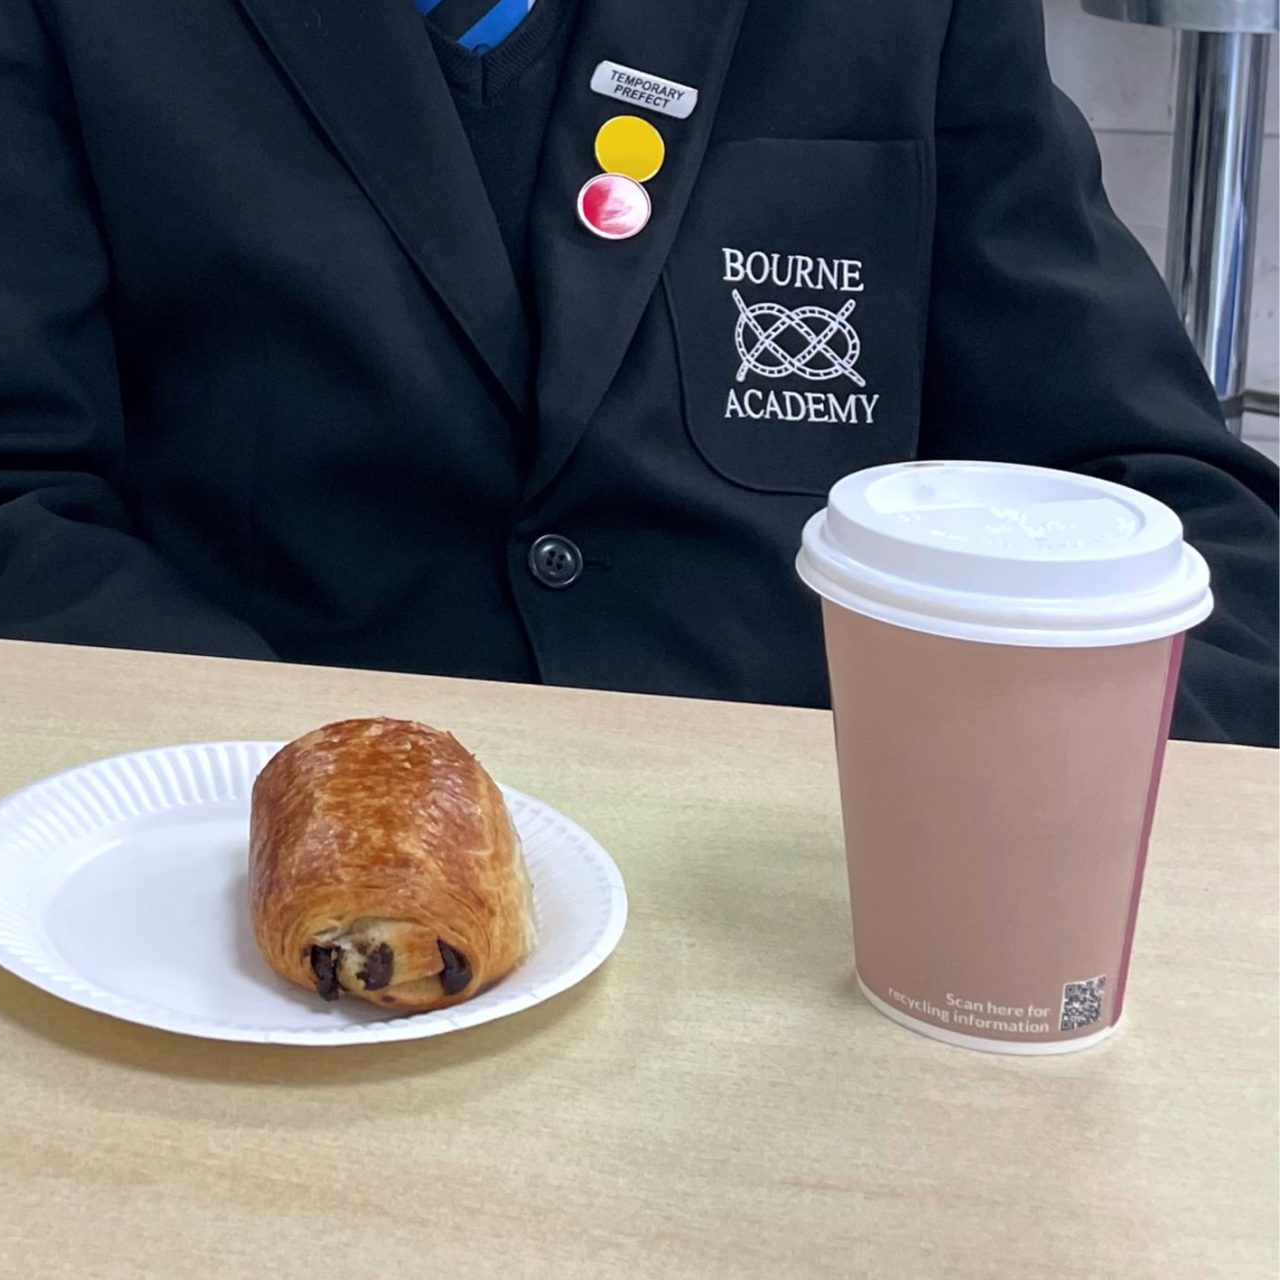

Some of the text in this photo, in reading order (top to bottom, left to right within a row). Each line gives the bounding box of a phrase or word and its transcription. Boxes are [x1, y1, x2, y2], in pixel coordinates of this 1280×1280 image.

[610, 69, 685, 101] TEMPORARY
[613, 84, 671, 109] PREFECT
[722, 248, 864, 292] BOURNE
[724, 388, 879, 424] ACADEMY
[888, 987, 1050, 1033] recycling information
[945, 992, 1051, 1018] Scan here for
